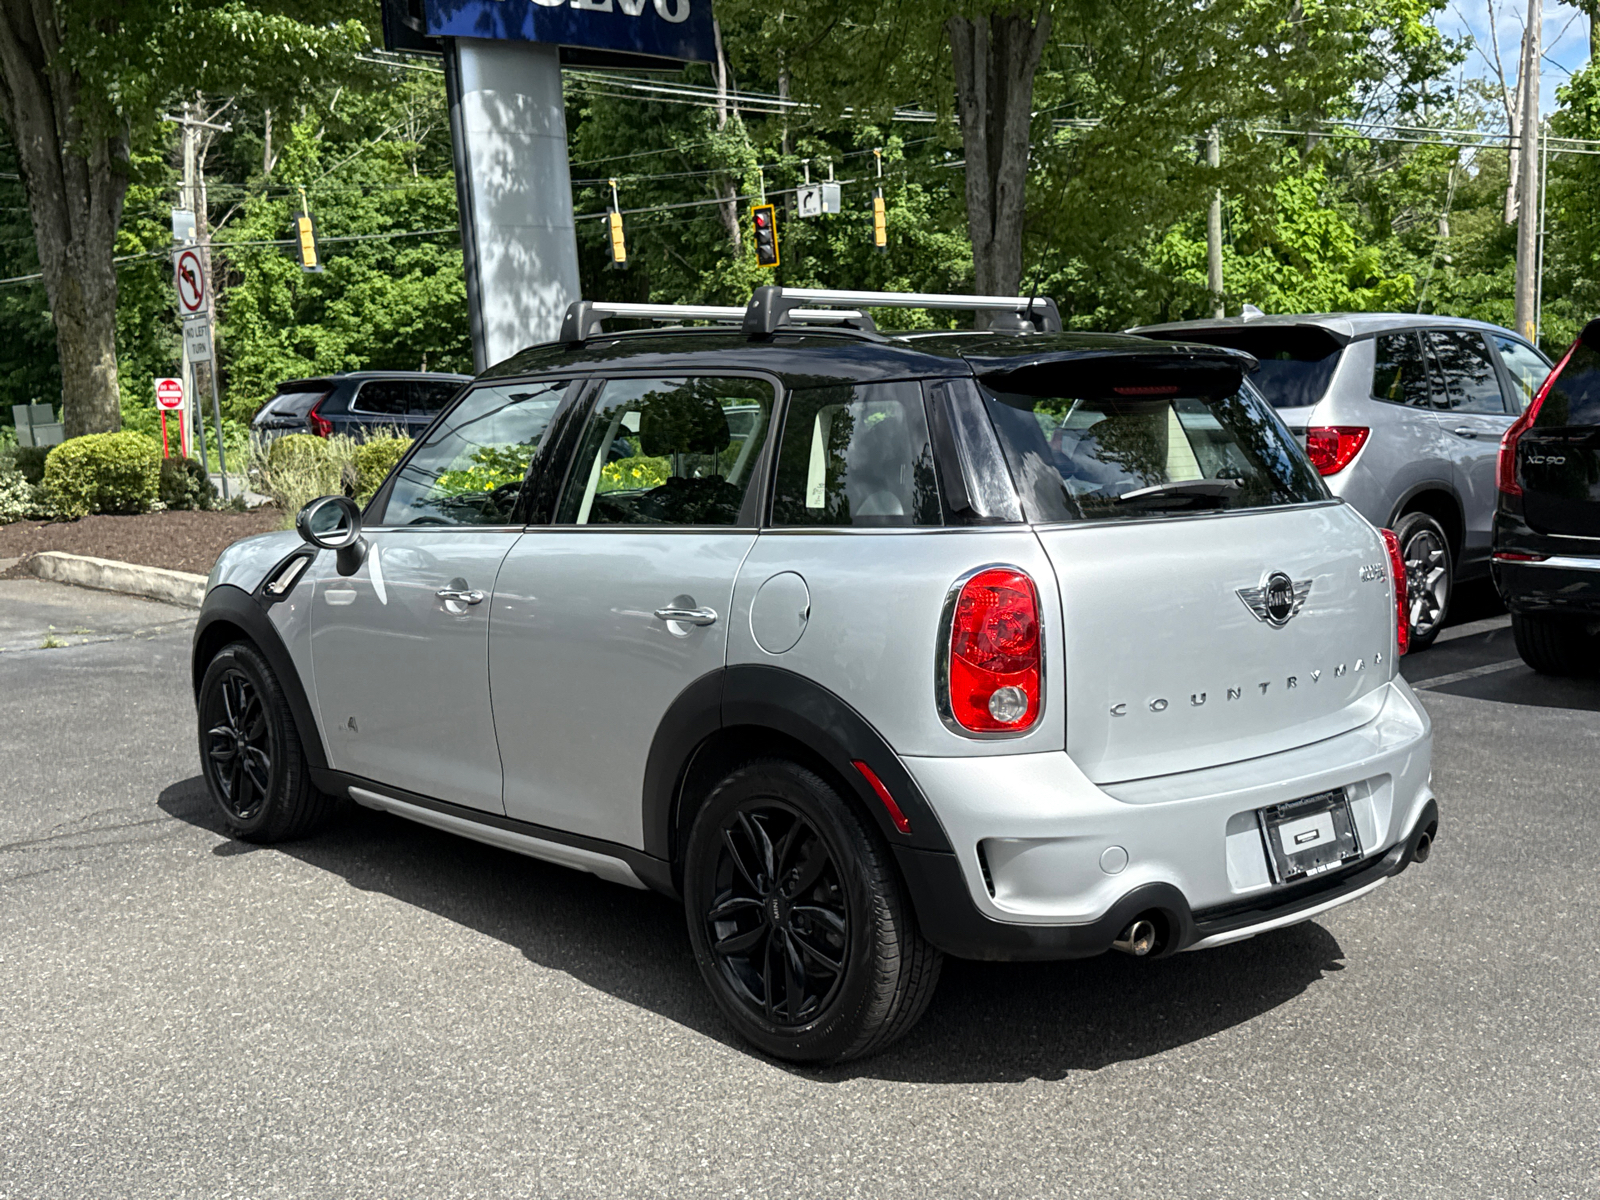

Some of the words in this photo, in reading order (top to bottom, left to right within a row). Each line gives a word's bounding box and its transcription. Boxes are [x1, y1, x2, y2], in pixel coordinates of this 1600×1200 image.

[186, 327, 194, 338] NO
[195, 326, 207, 337] LEFT
[192, 342, 206, 354] TURN
[1109, 652, 1383, 717] COUNTRYMAN
